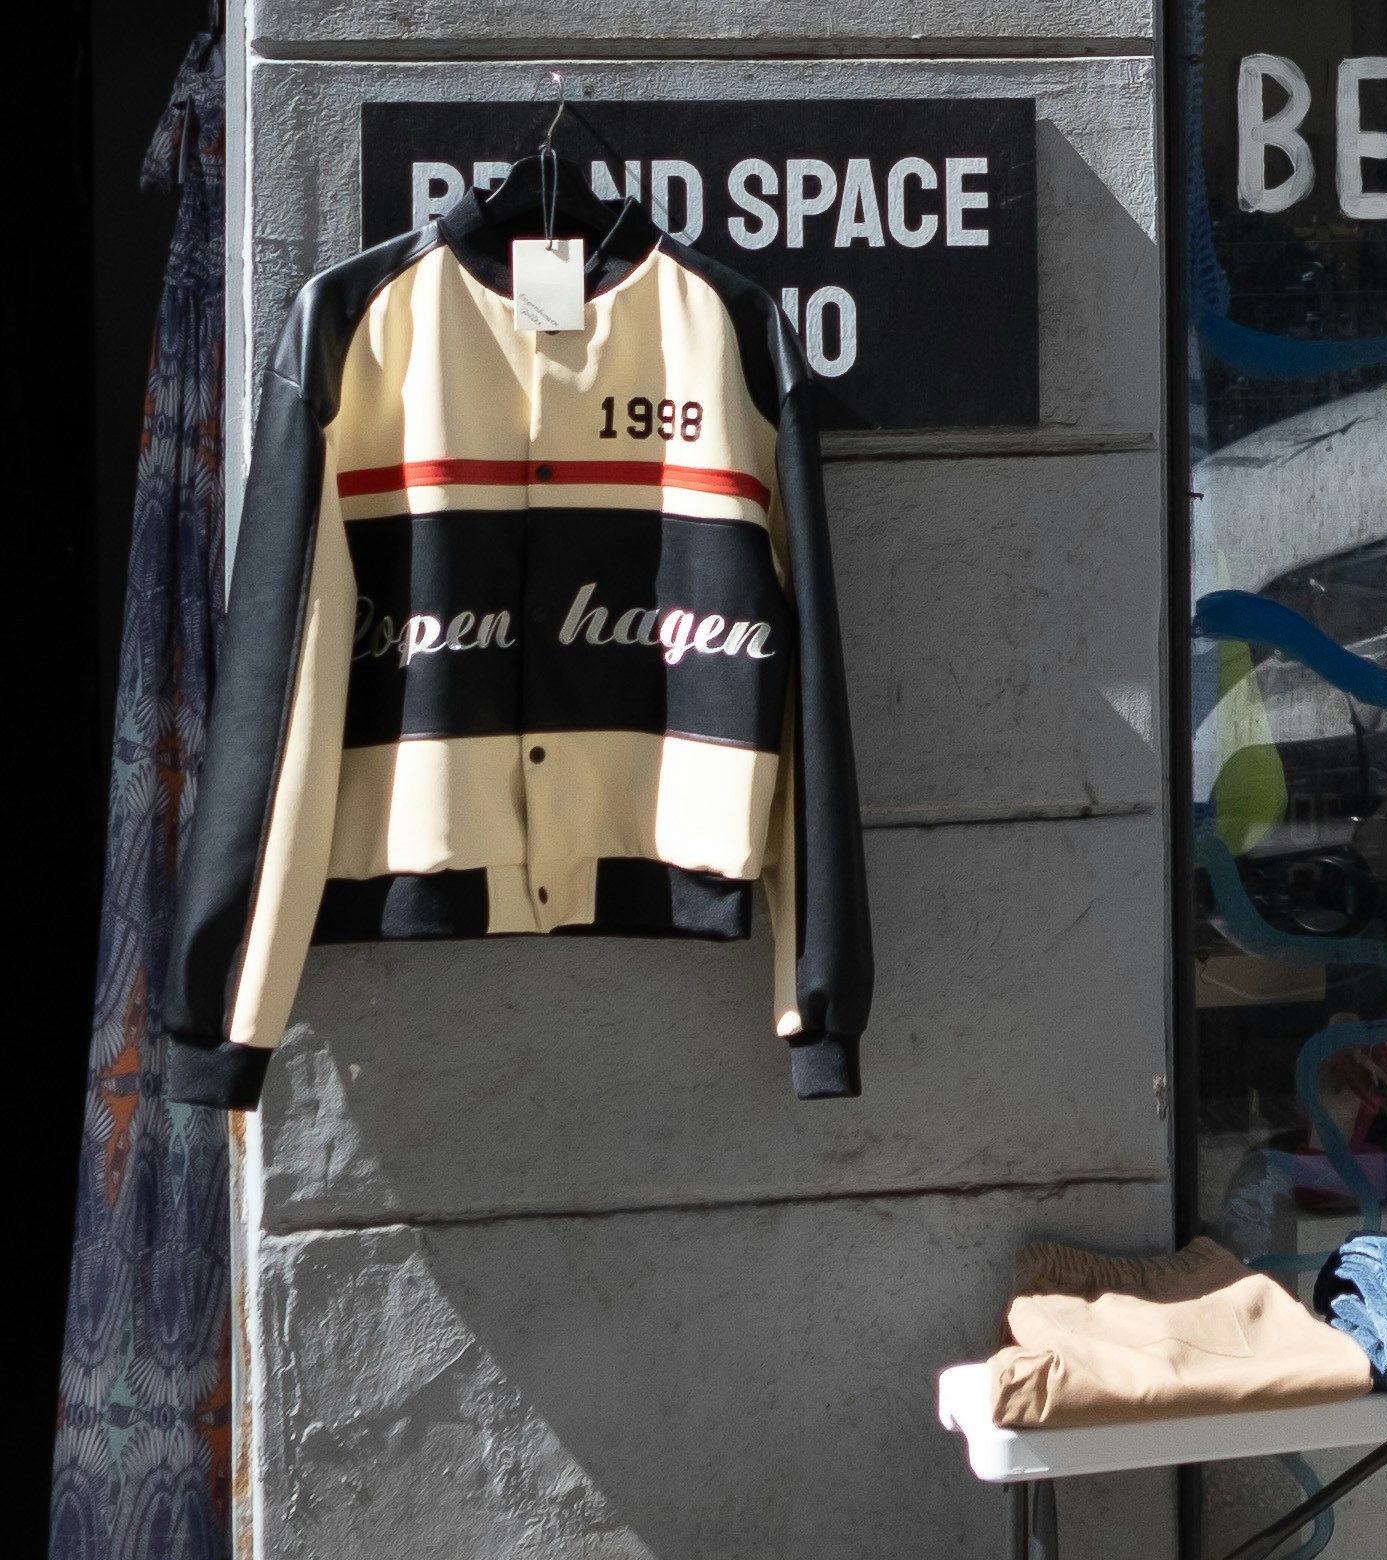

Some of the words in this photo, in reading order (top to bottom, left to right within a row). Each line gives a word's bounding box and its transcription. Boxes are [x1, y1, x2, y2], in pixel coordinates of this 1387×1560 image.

[412, 159, 703, 246] BND
[727, 157, 989, 250] SPACE
[599, 396, 704, 442] 1998
[558, 582, 776, 665] hagen
